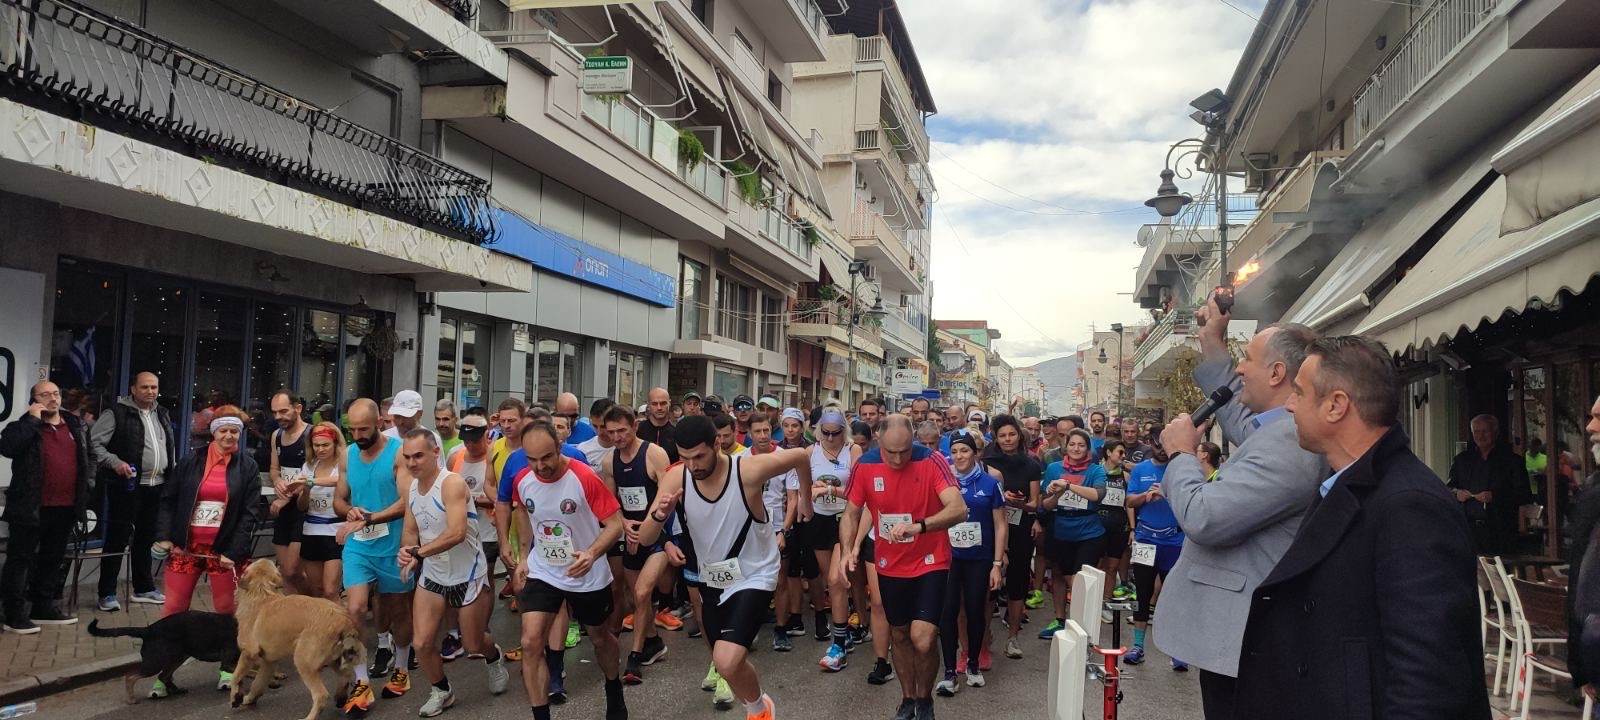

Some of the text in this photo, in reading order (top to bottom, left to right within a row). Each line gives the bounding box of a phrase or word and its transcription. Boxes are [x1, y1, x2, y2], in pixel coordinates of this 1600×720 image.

[624, 494, 640, 505] 185
[197, 509, 220, 521] 372
[954, 530, 975, 542] 285
[543, 547, 567, 559] 243
[708, 571, 734, 583] 268
